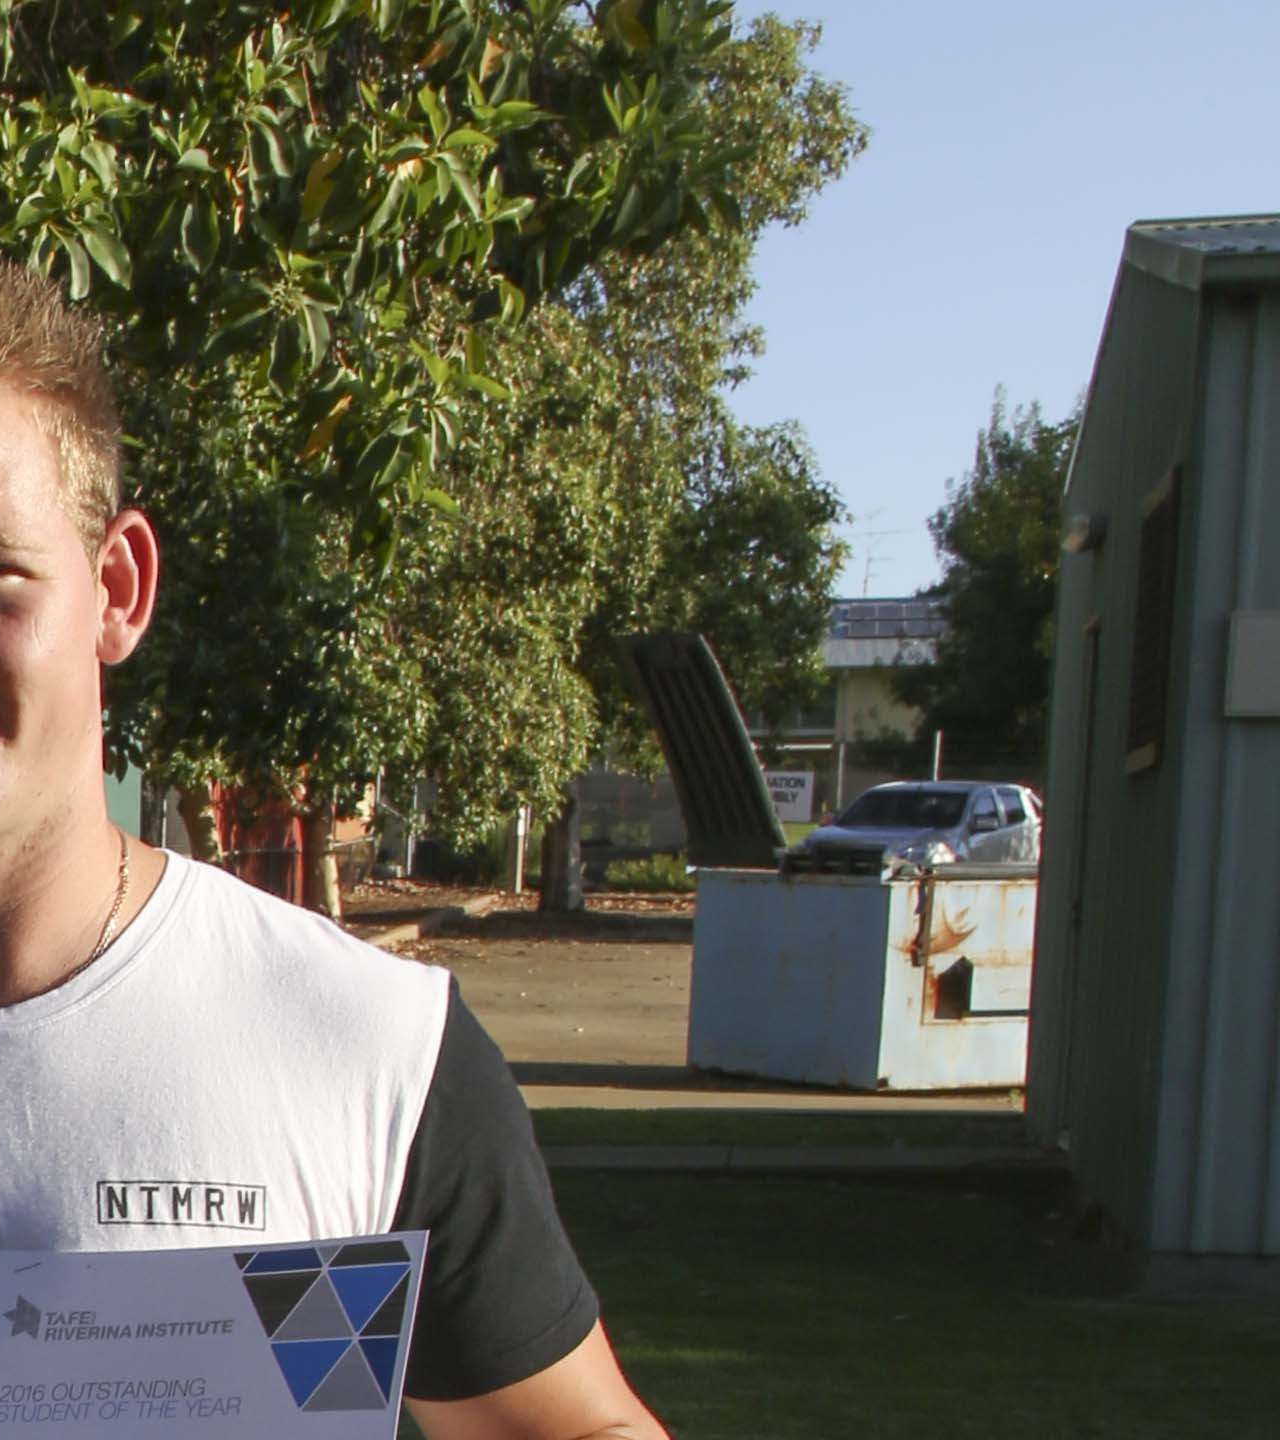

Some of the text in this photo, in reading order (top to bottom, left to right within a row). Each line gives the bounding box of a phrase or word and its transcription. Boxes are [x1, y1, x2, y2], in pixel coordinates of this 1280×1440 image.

[107, 1186, 256, 1225] NTMRW
[45, 1311, 91, 1326] TAFE
[44, 1319, 234, 1343] RIVERINA INSTITUTE
[51, 1377, 207, 1402] OUTSTANDING
[99, 1401, 131, 1420] OF
[138, 1400, 178, 1419] THE
[187, 1396, 242, 1417] YEAR
